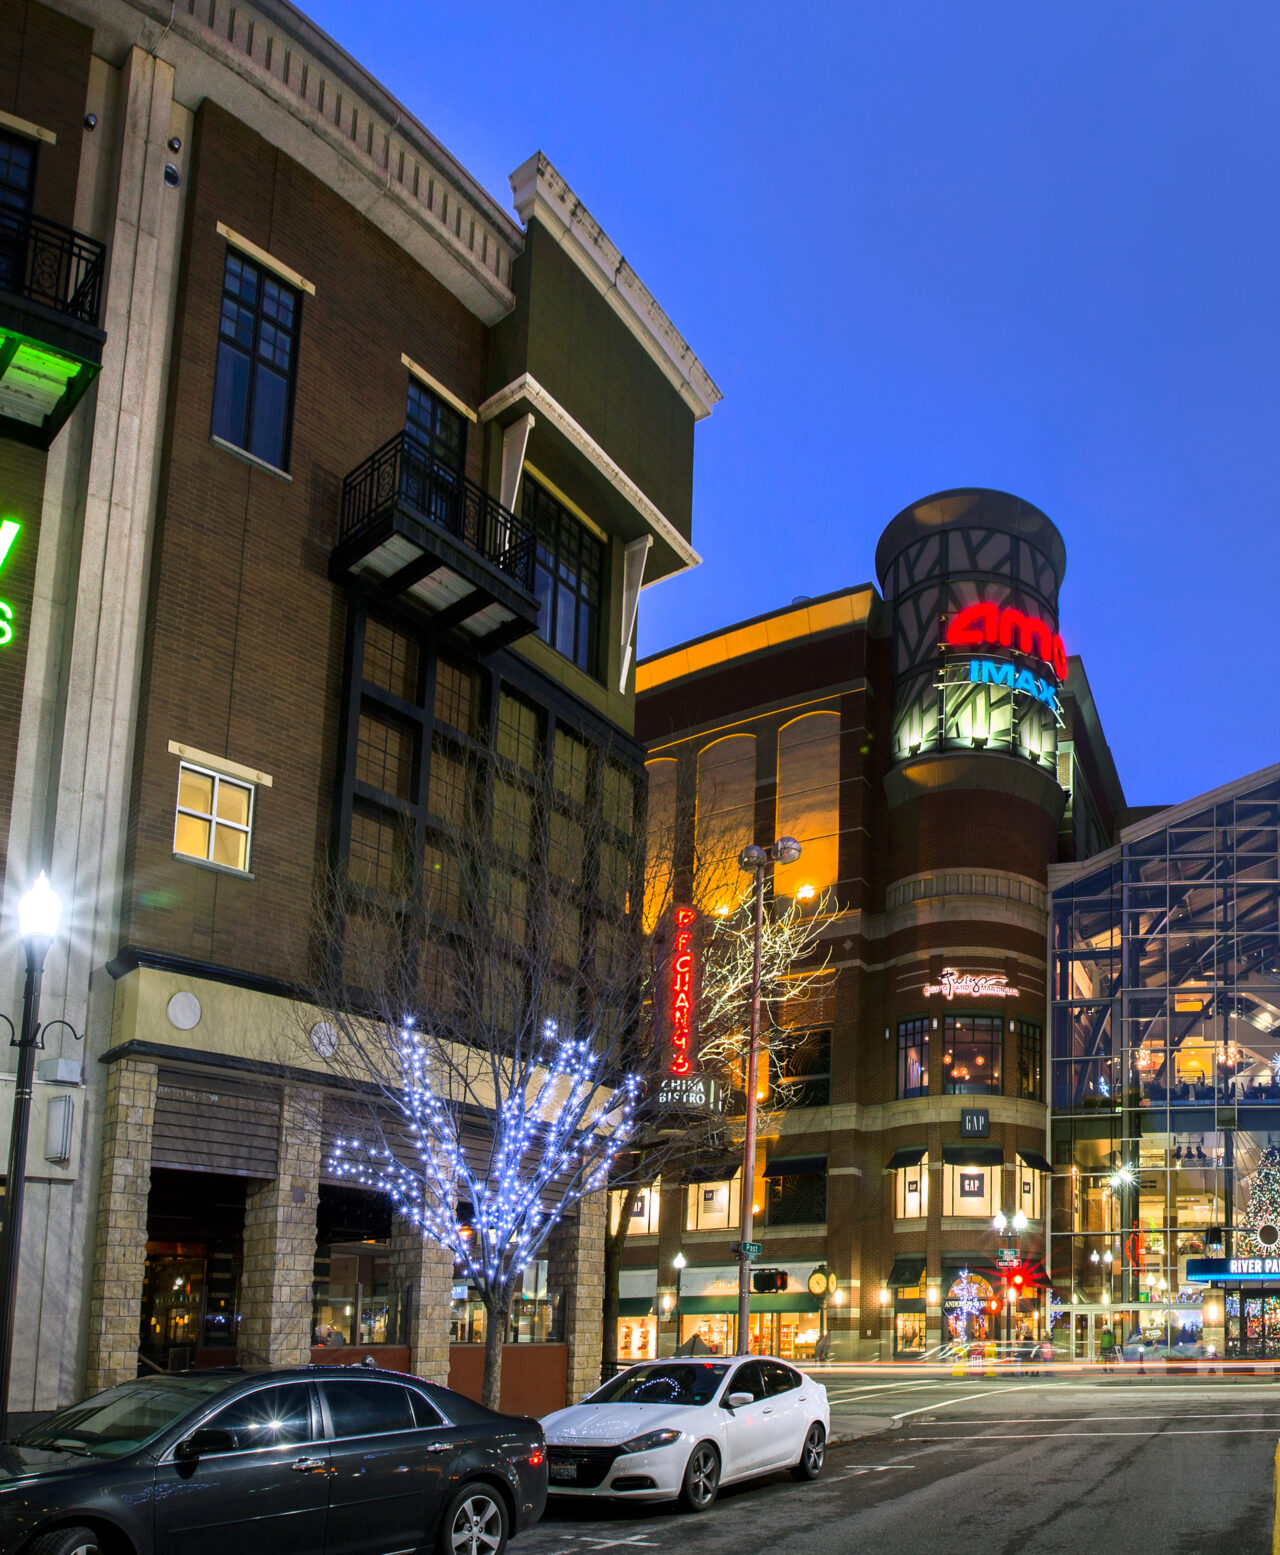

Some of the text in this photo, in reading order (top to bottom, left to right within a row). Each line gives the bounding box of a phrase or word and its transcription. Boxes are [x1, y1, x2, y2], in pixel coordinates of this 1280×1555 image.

[970, 660, 1057, 710] IMAX
[661, 1080, 704, 1092] CHINA
[659, 1092, 705, 1104] BISTRO
[966, 1115, 984, 1131] GAP
[965, 1180, 979, 1191] GAP
[746, 1243, 758, 1253] Post
[1231, 1260, 1262, 1273] RIVER
